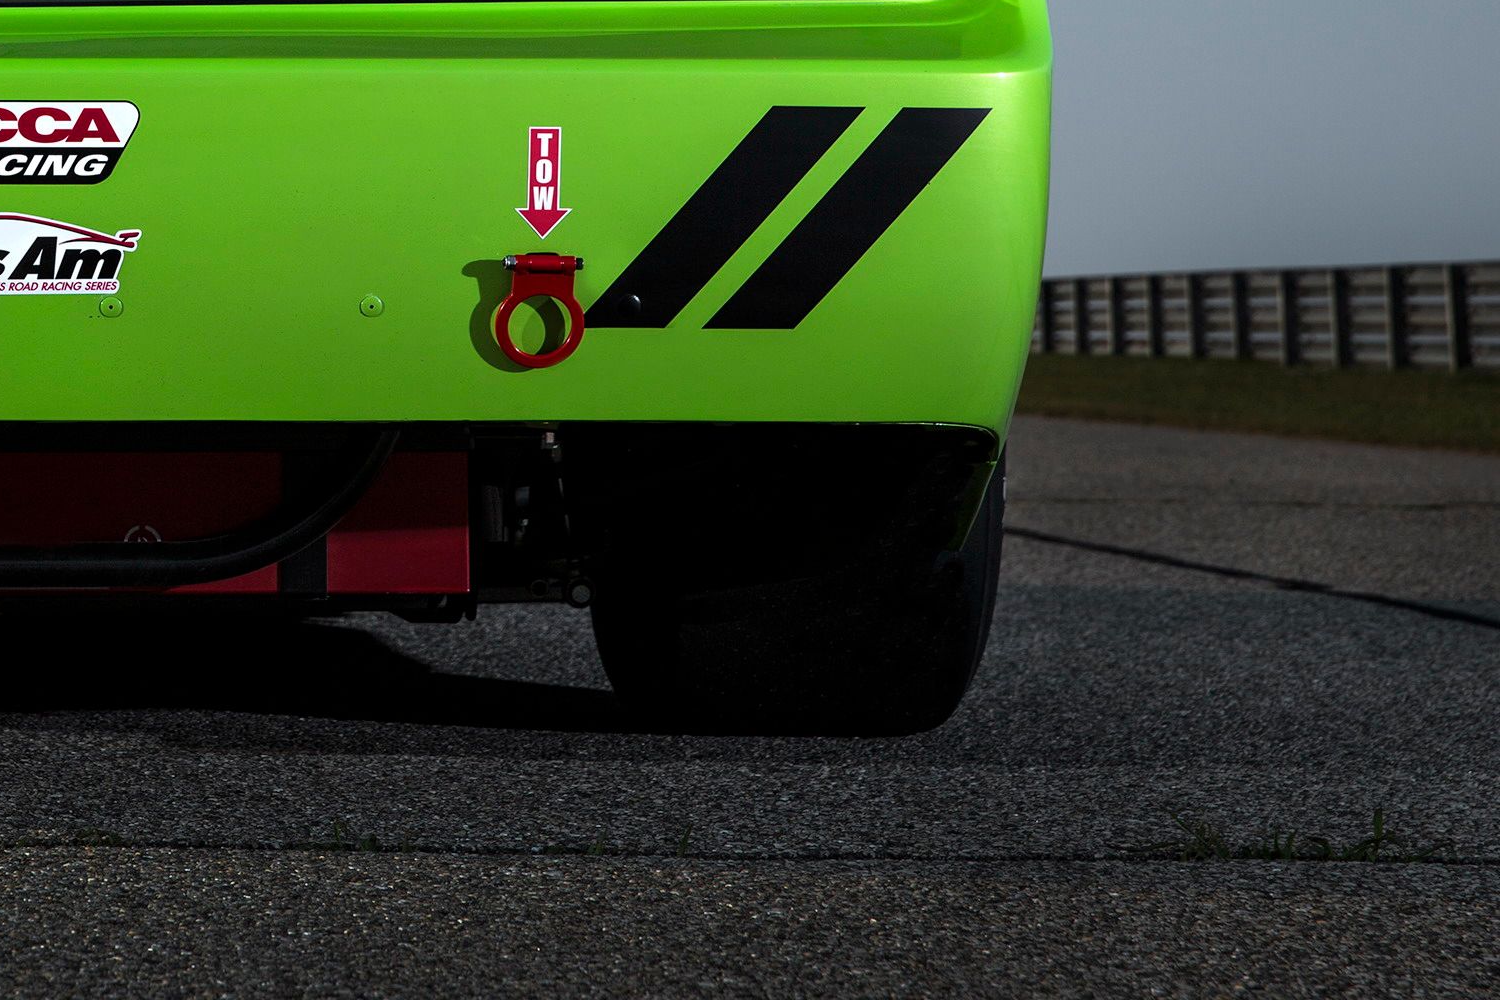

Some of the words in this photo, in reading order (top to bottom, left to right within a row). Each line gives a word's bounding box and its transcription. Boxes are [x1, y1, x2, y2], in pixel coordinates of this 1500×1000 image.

[533, 133, 554, 210] TOW
[9, 236, 122, 280] Am
[8, 282, 39, 292] ROAD
[41, 281, 82, 291] RACING
[84, 281, 117, 291] SERIES
